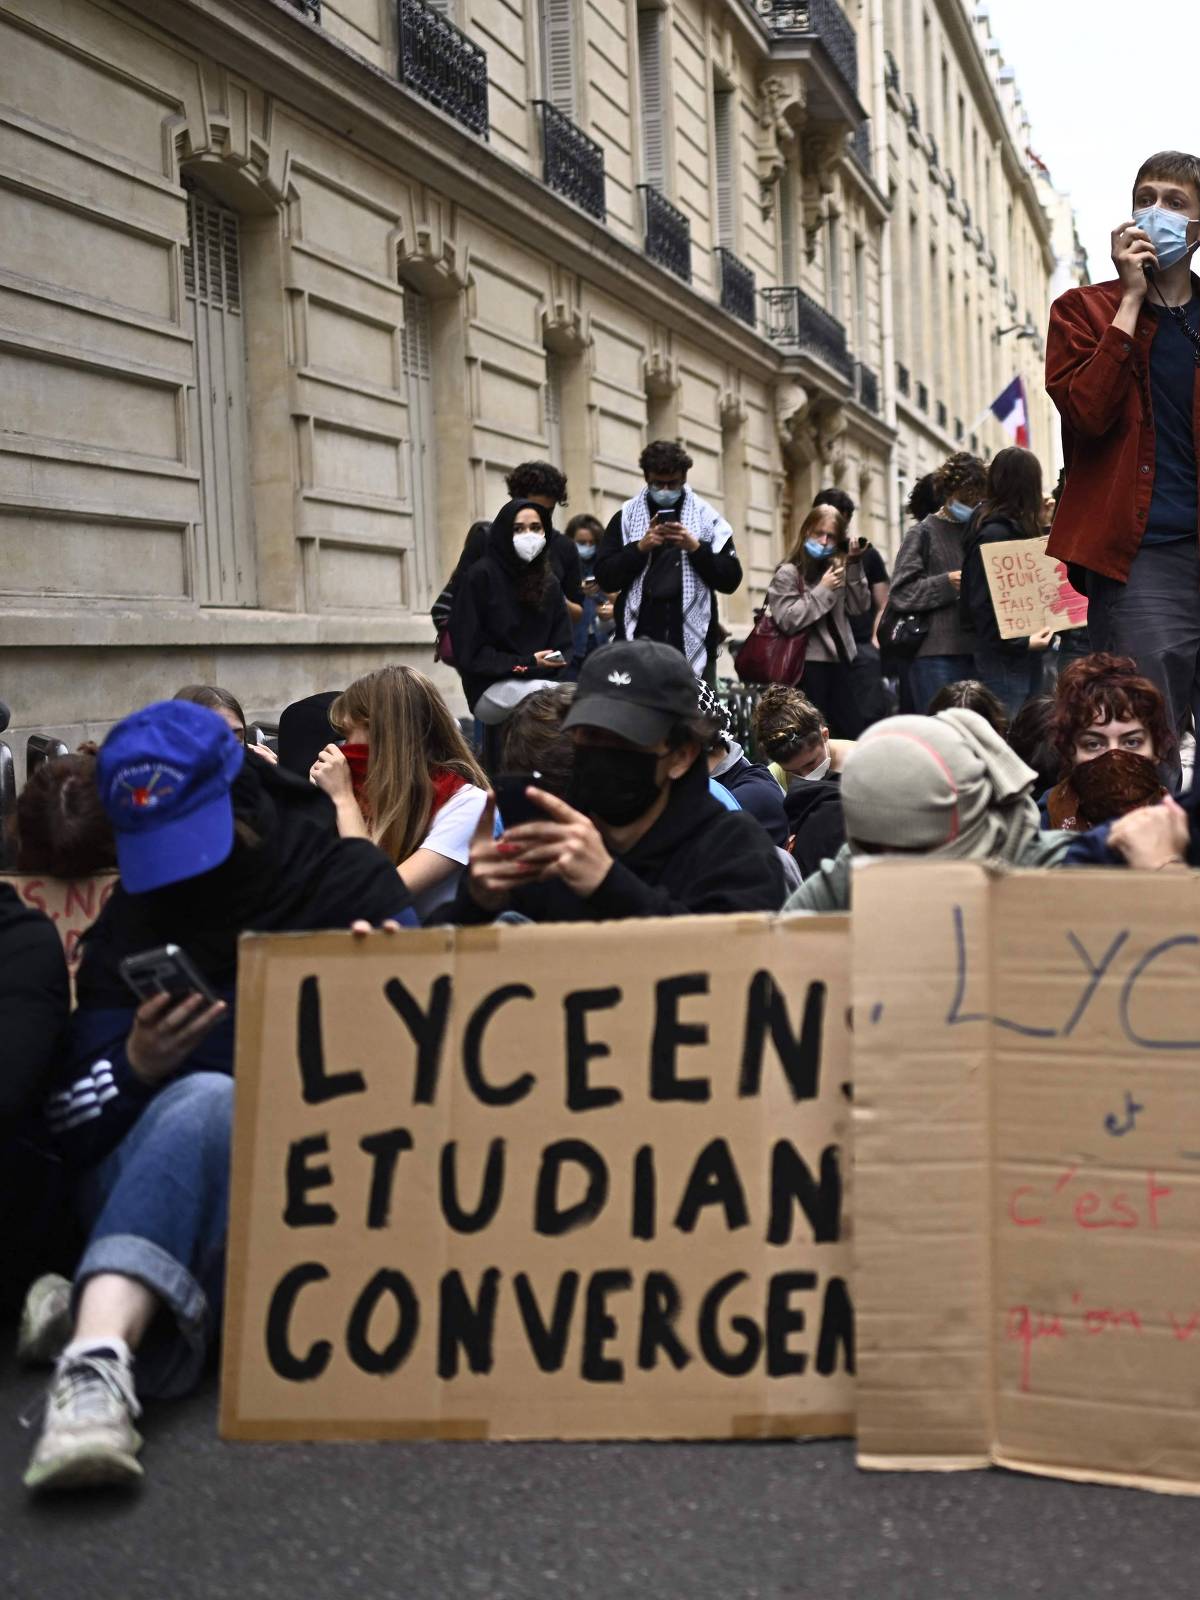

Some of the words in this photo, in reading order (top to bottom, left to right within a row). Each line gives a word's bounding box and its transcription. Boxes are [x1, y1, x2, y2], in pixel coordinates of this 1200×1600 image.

[991, 552, 1036, 574] SOIS
[996, 568, 1046, 591] JEUNE
[999, 597, 1034, 613] TAIS
[1005, 616, 1031, 630] TOI
[297, 968, 853, 1111] LYCEEN
[1105, 1093, 1145, 1136] et
[283, 1127, 843, 1246] ETUDIAN
[1008, 1166, 1173, 1230] c'est
[266, 1261, 855, 1384] CONVERGEN
